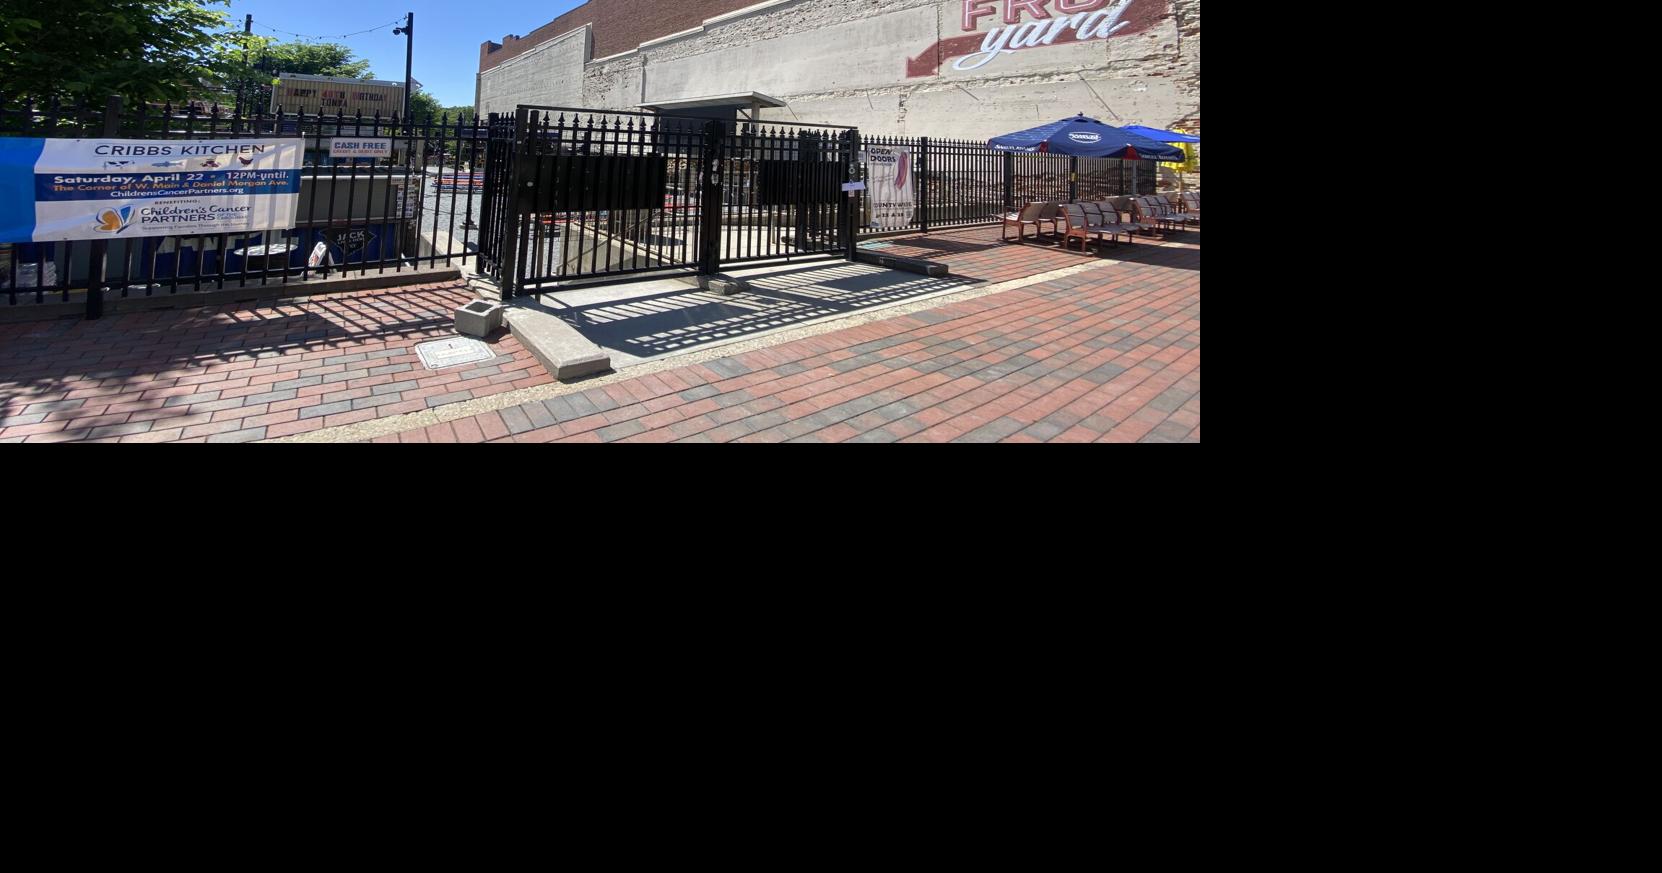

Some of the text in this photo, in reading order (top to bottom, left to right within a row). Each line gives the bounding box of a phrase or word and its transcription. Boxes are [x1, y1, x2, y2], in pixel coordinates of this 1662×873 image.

[952, 0, 1132, 71] yard
[94, 144, 265, 156] CRIBBS KITCHEN
[870, 147, 893, 155] OPEN
[54, 171, 289, 185] Saturday, April 22 12PM-until.
[54, 184, 74, 192] The
[77, 184, 118, 192] Corner
[120, 183, 131, 191] of
[134, 182, 150, 190] W.
[153, 181, 180, 189] Main
[192, 180, 225, 188] Daniel
[228, 180, 266, 188] Morgan
[110, 187, 244, 198] ChildrensCancerPartners.org
[141, 204, 252, 216] Children's Cancer
[141, 213, 215, 224] PARTNERS
